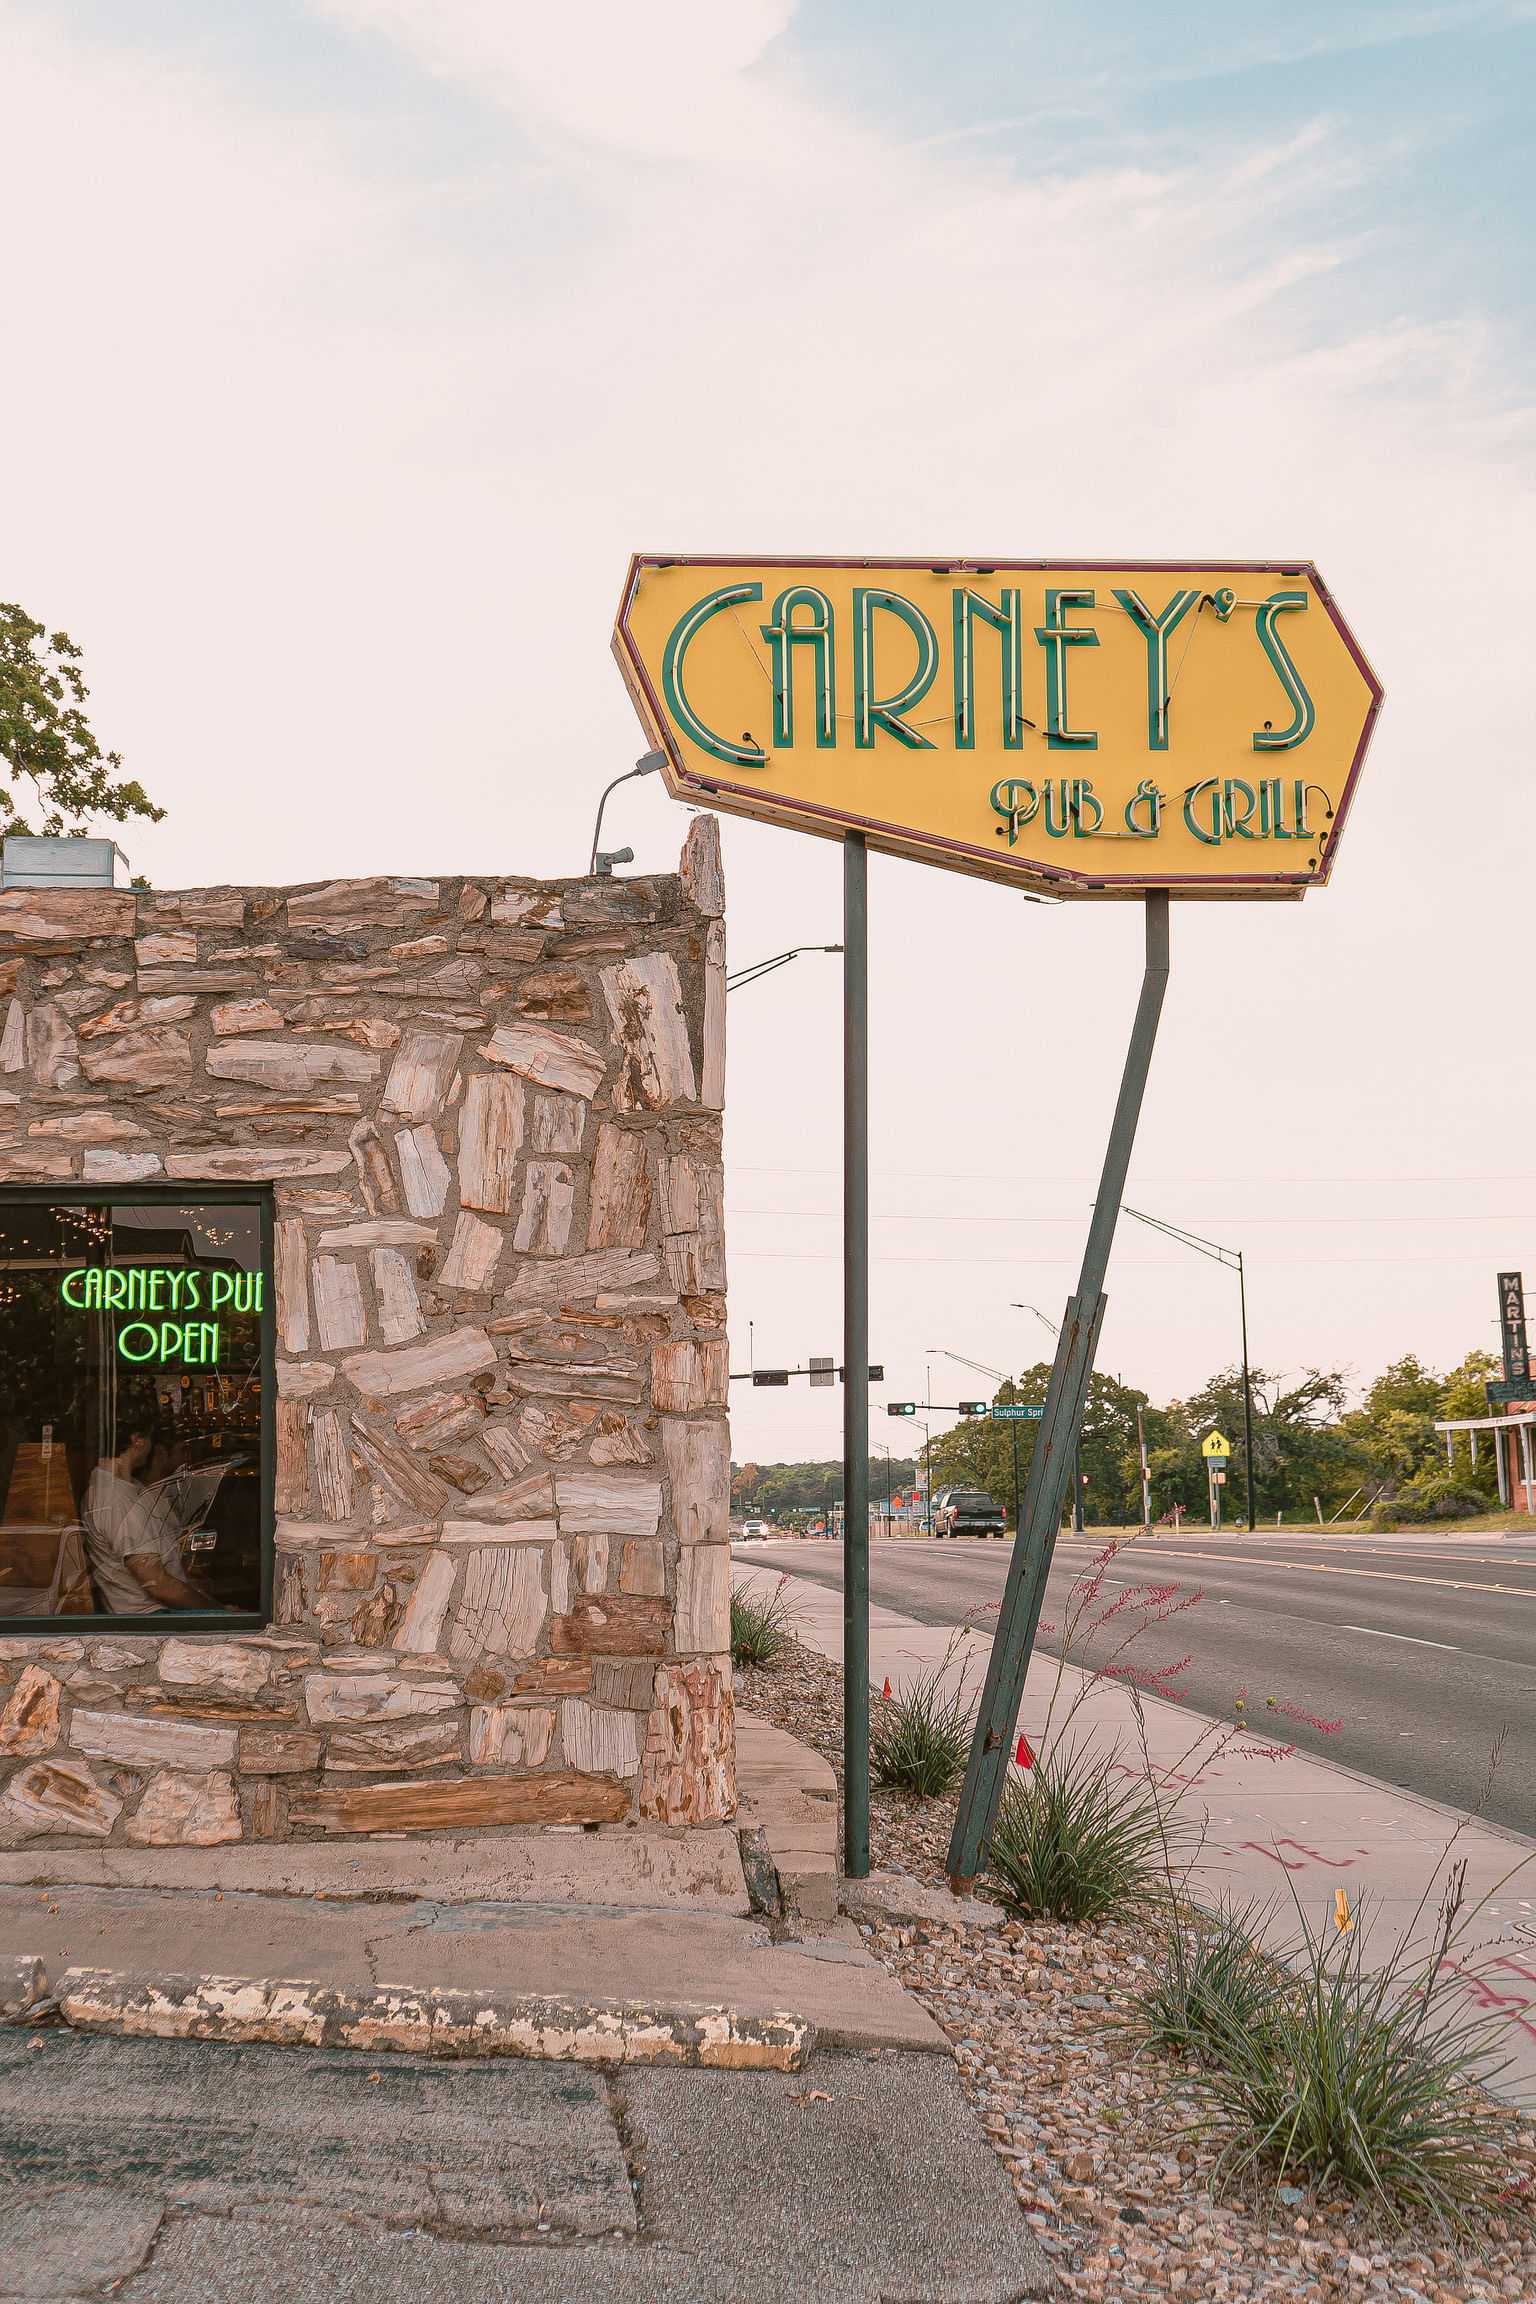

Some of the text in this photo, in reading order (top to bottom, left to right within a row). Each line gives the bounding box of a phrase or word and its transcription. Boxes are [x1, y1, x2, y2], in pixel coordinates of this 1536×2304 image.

[661, 582, 1316, 768] CARNEY'S
[989, 776, 1314, 847] PUB & GRILL
[61, 1268, 201, 1310] CARNEYS
[118, 1322, 219, 1363] OPEN
[1503, 1278, 1525, 1376] MARTINS
[994, 1408, 1025, 1417] Sulphur
